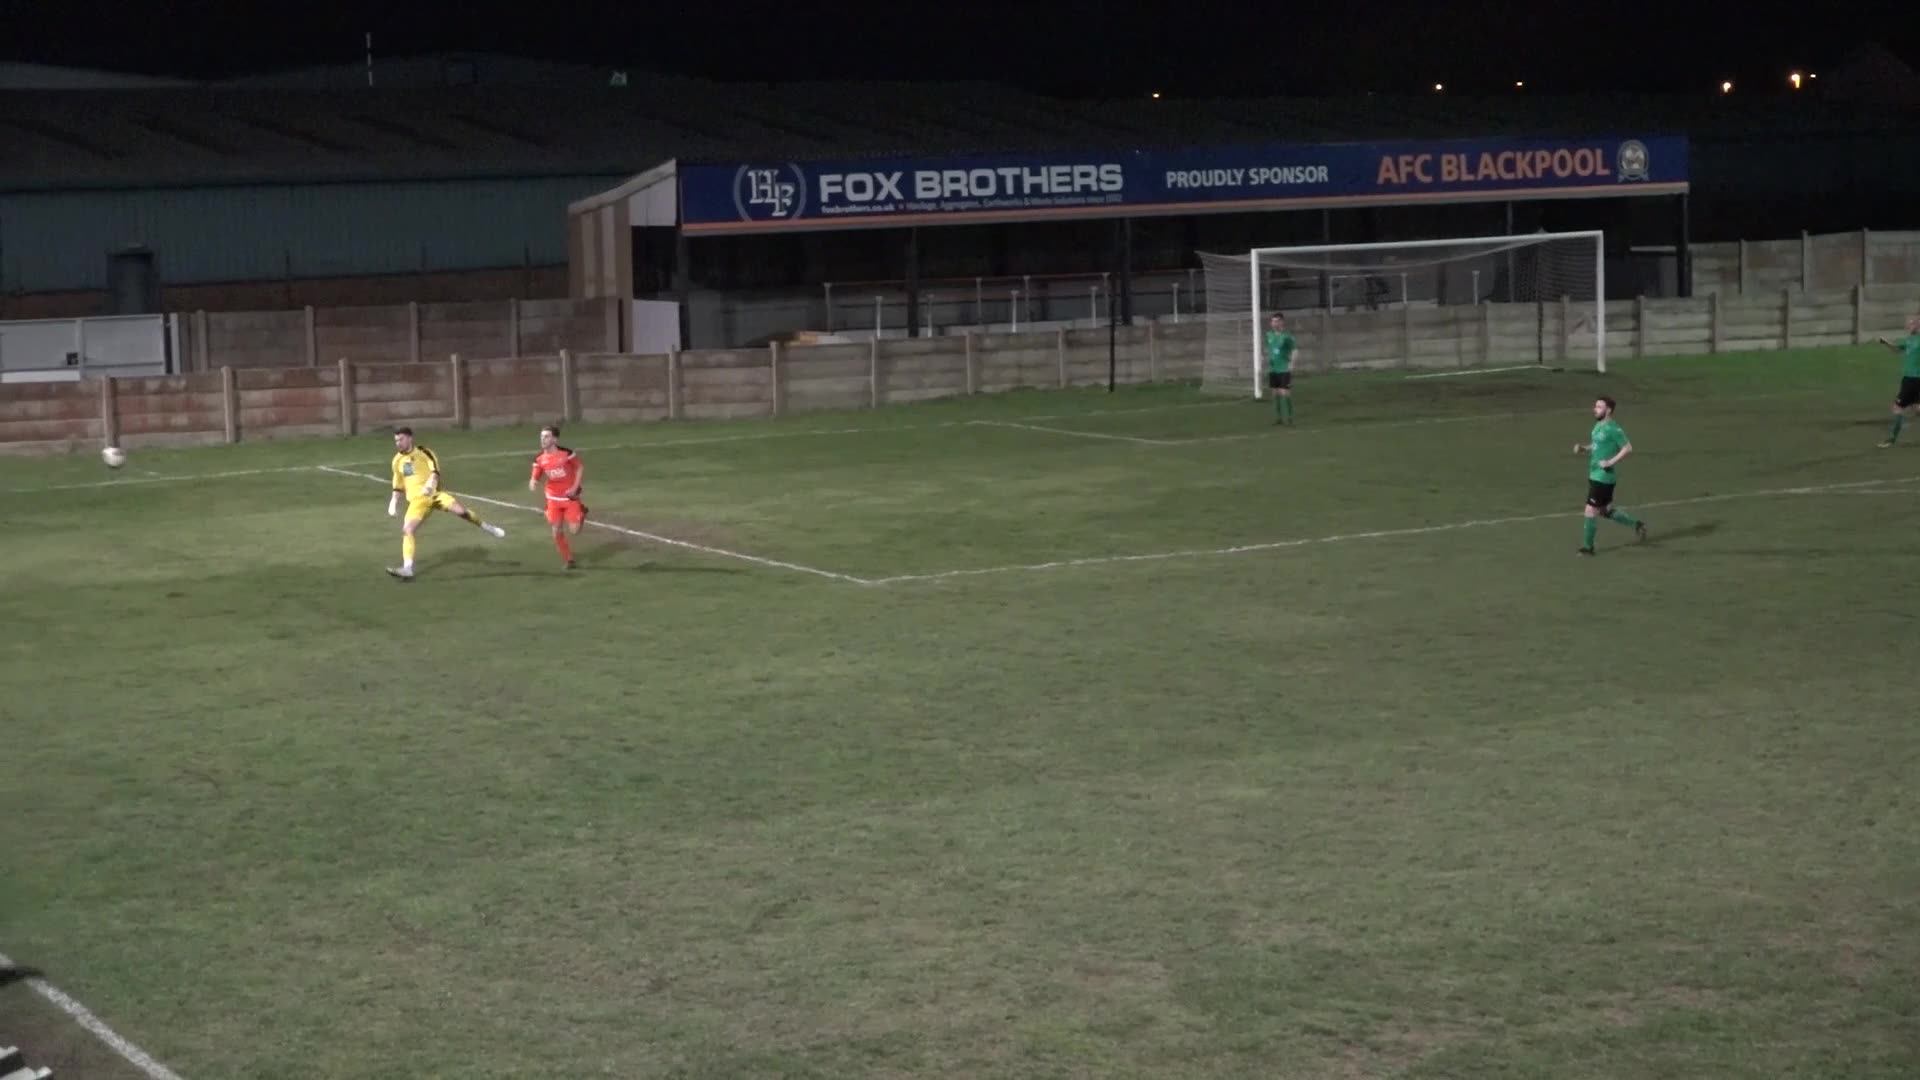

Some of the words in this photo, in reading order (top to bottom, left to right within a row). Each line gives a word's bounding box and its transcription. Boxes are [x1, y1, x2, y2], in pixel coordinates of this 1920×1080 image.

[819, 172, 904, 203] FOX
[915, 163, 1124, 199] BROTHERS
[1166, 168, 1246, 189] PROUDLY
[1249, 165, 1329, 185] SPONSOR
[1376, 155, 1433, 185] AFC
[1440, 149, 1611, 182] BLACKPOOL
